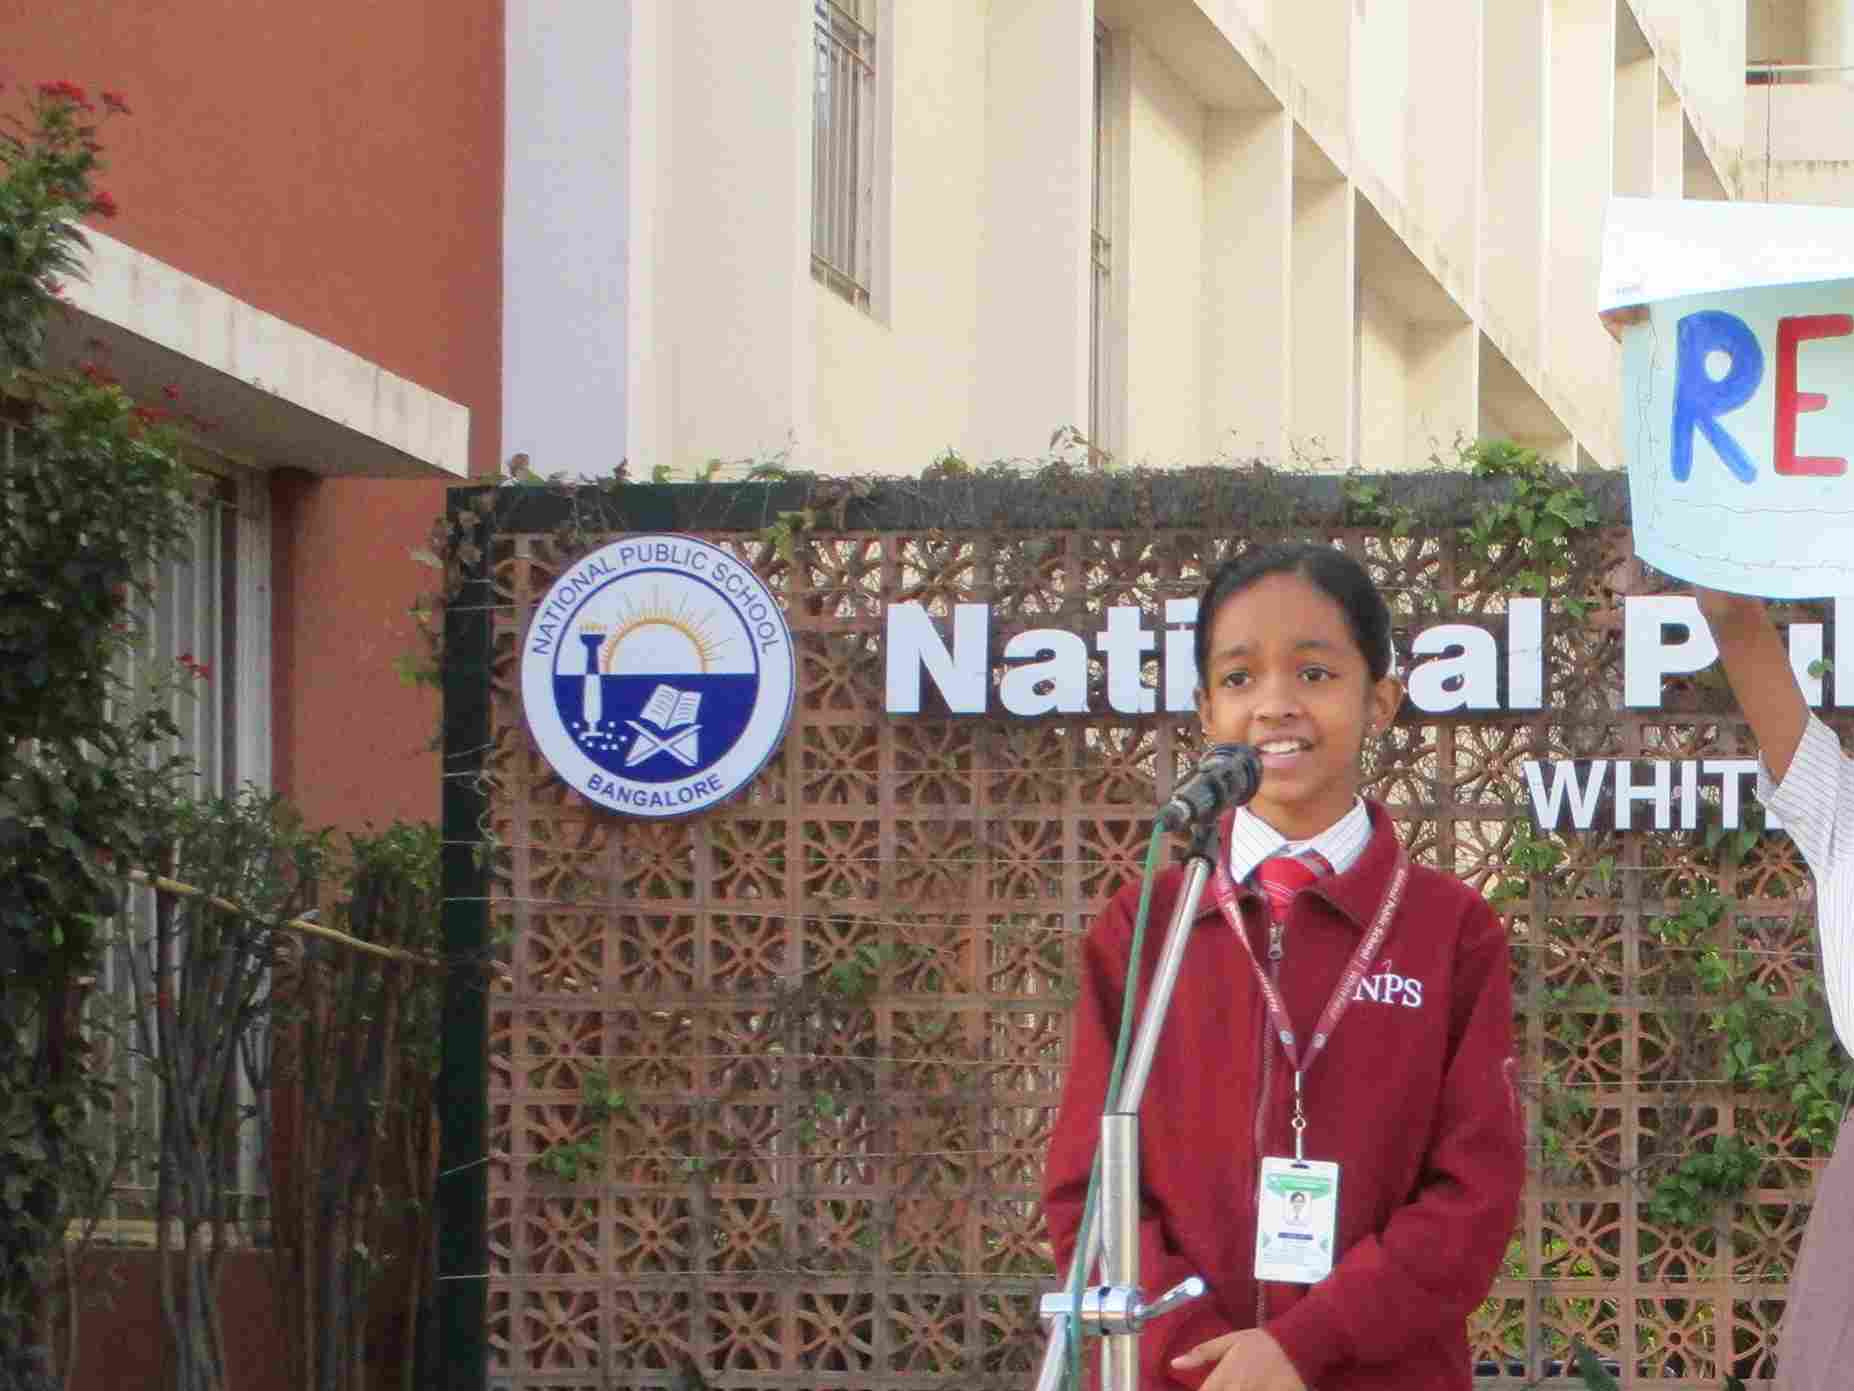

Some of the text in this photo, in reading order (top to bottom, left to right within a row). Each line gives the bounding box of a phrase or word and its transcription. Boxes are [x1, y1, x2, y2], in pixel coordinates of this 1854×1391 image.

[532, 543, 779, 655] NATIONAL PUBLIC SCHOOL
[884, 597, 1543, 715] Natial
[587, 773, 722, 807] BANGALORE
[1353, 973, 1424, 1008] NPS
